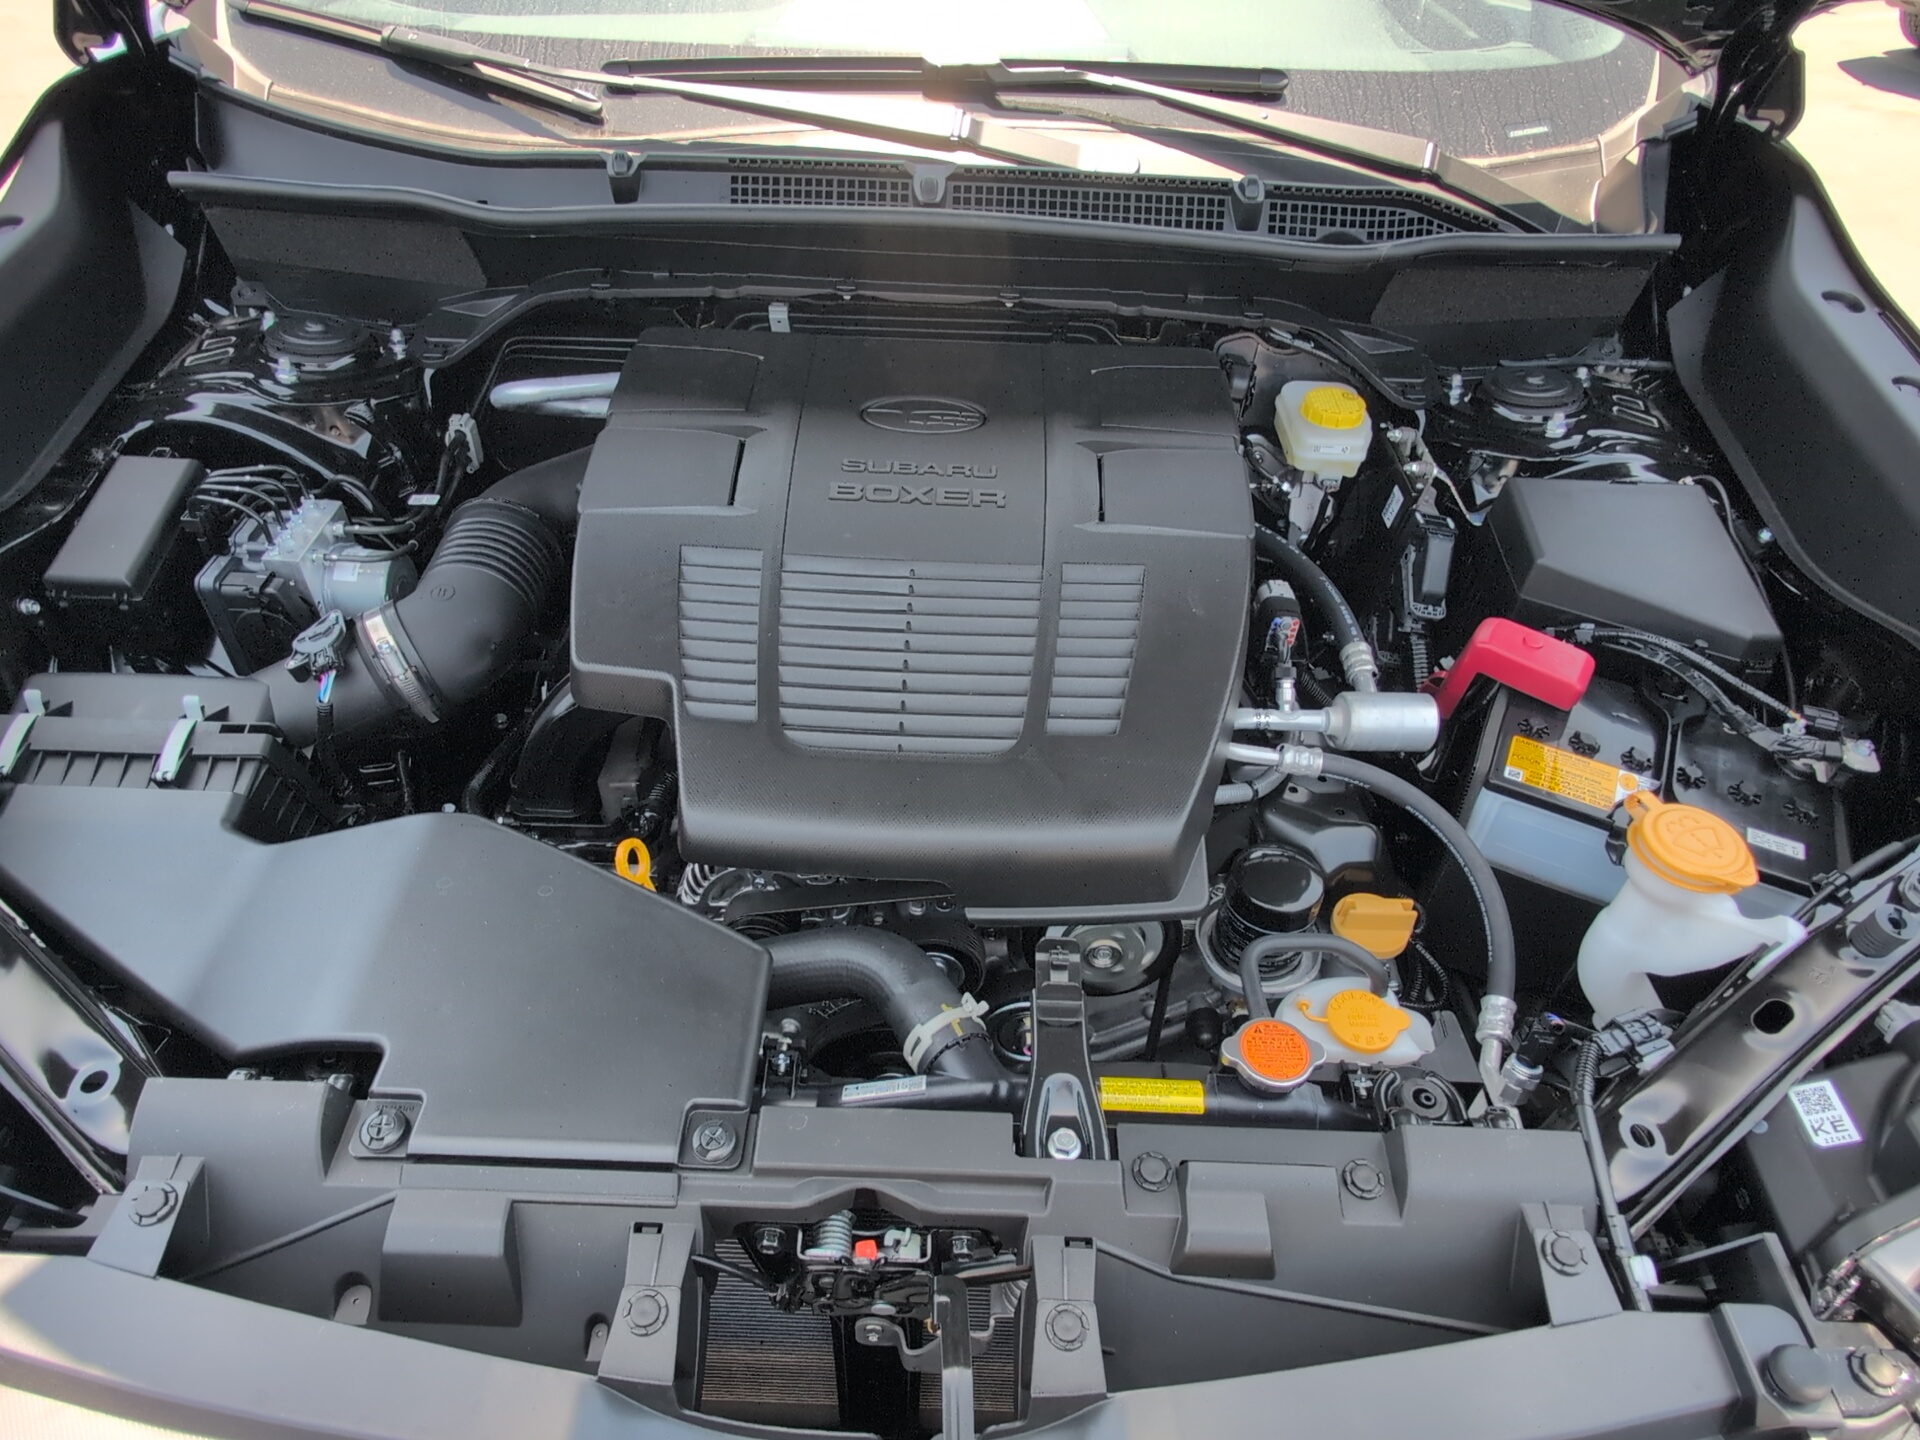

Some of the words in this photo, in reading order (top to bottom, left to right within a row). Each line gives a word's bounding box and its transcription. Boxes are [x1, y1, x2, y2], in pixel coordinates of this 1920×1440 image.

[841, 458, 998, 479] SUBARU
[828, 482, 1007, 508] BOXER
[1810, 1119, 1850, 1137] KE
